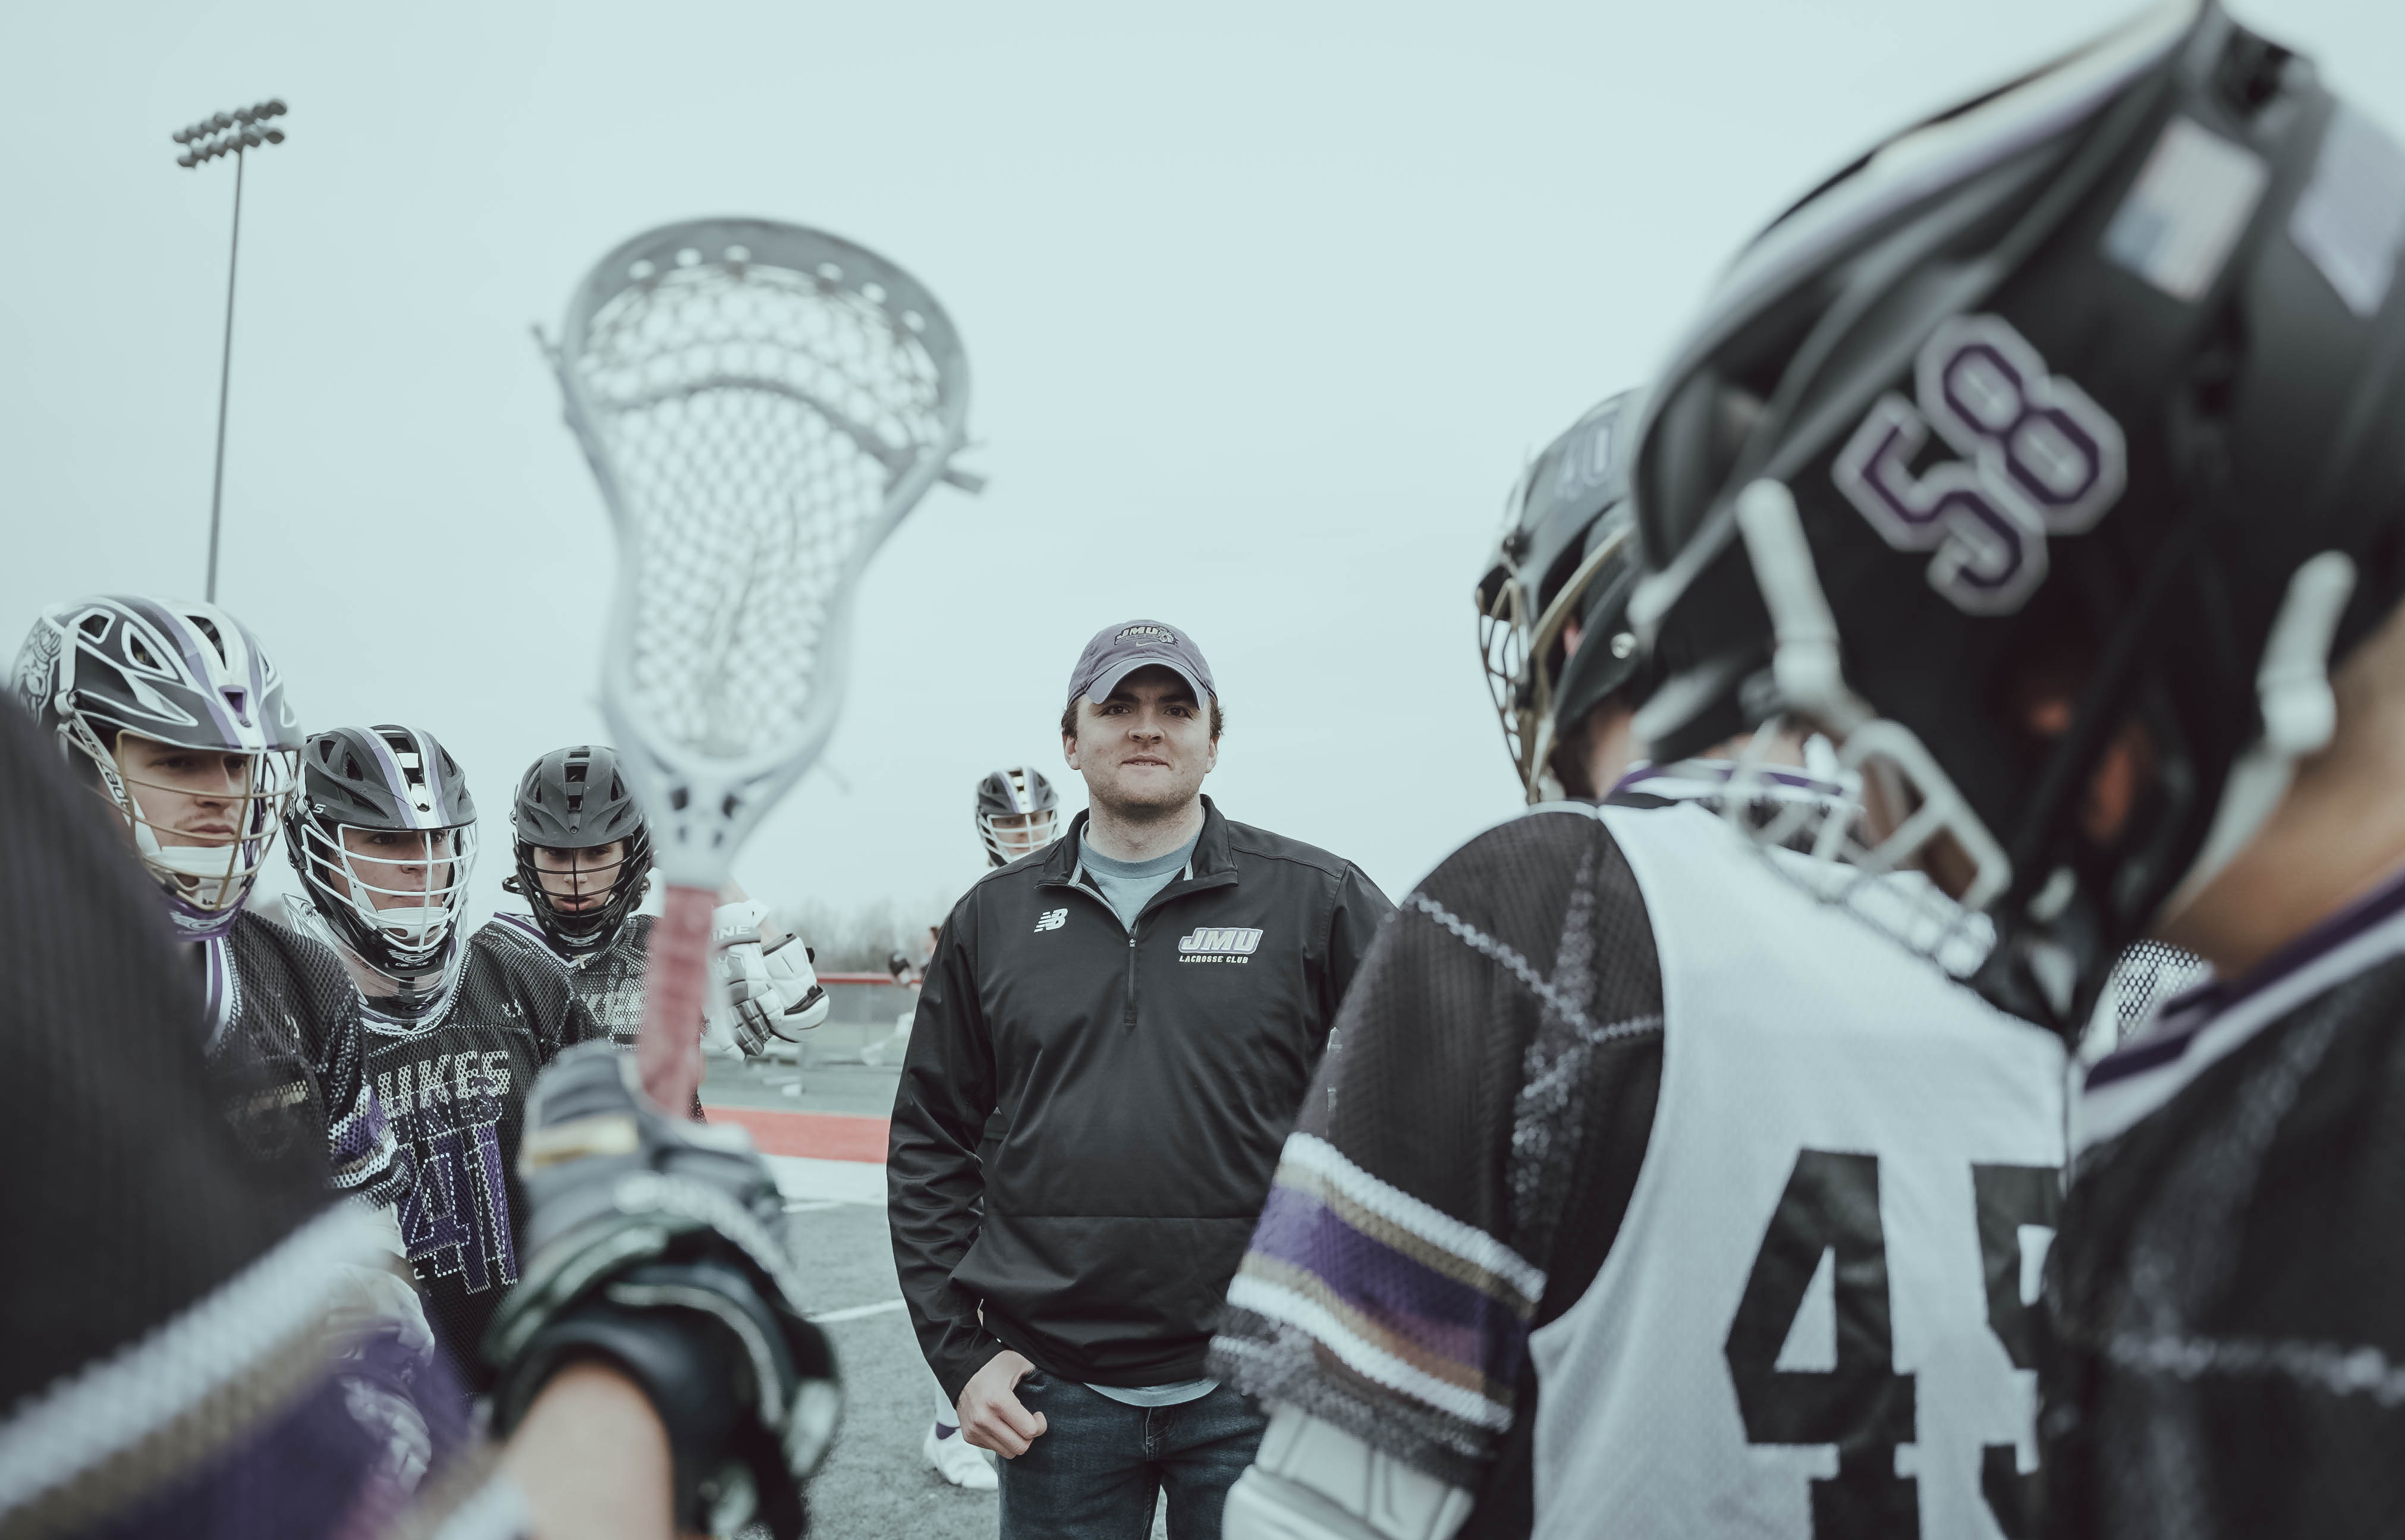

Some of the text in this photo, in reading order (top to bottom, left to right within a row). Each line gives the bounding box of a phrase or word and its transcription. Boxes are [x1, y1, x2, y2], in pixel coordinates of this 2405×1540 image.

[1834, 312, 2126, 616] 58
[1117, 626, 1159, 639] JMU
[1180, 929, 1260, 952] JMU
[378, 1050, 511, 1120] UKES
